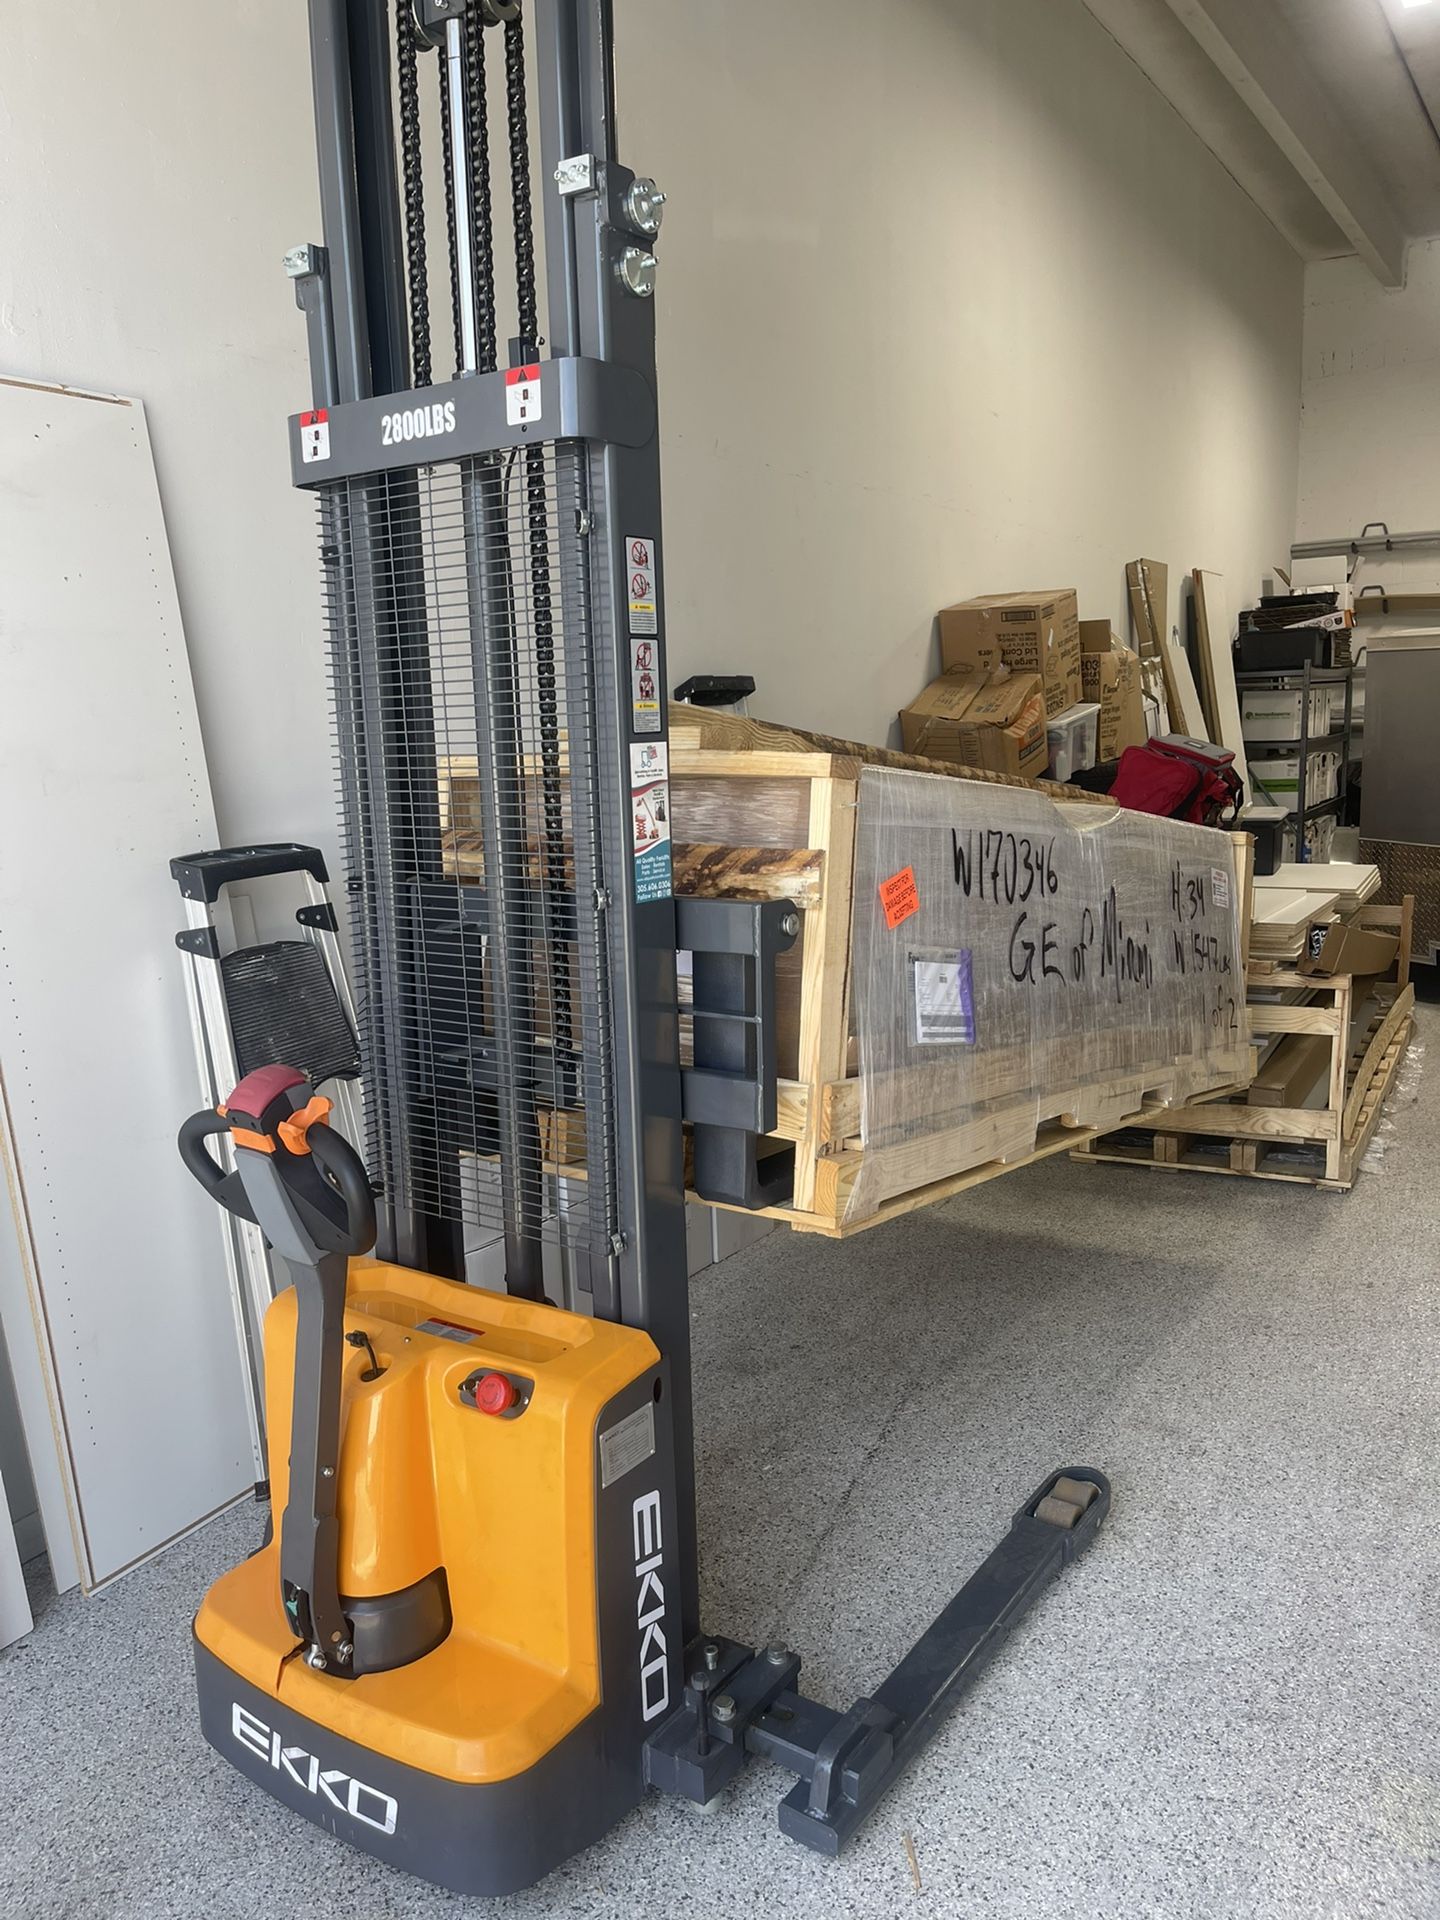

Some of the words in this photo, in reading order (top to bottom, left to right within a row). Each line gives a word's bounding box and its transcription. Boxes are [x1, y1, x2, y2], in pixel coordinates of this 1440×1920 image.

[381, 400, 456, 446] 2800LBS
[1014, 657, 1039, 667] Large
[1025, 647, 1038, 655] Lid
[951, 828, 1058, 905] W170346
[1186, 876, 1206, 919] 34
[1009, 911, 1067, 987] GE
[1073, 907, 1094, 982] of
[1228, 997, 1238, 1029] 2
[632, 1489, 669, 1722] EKKO
[232, 1702, 398, 1835] EKKO
